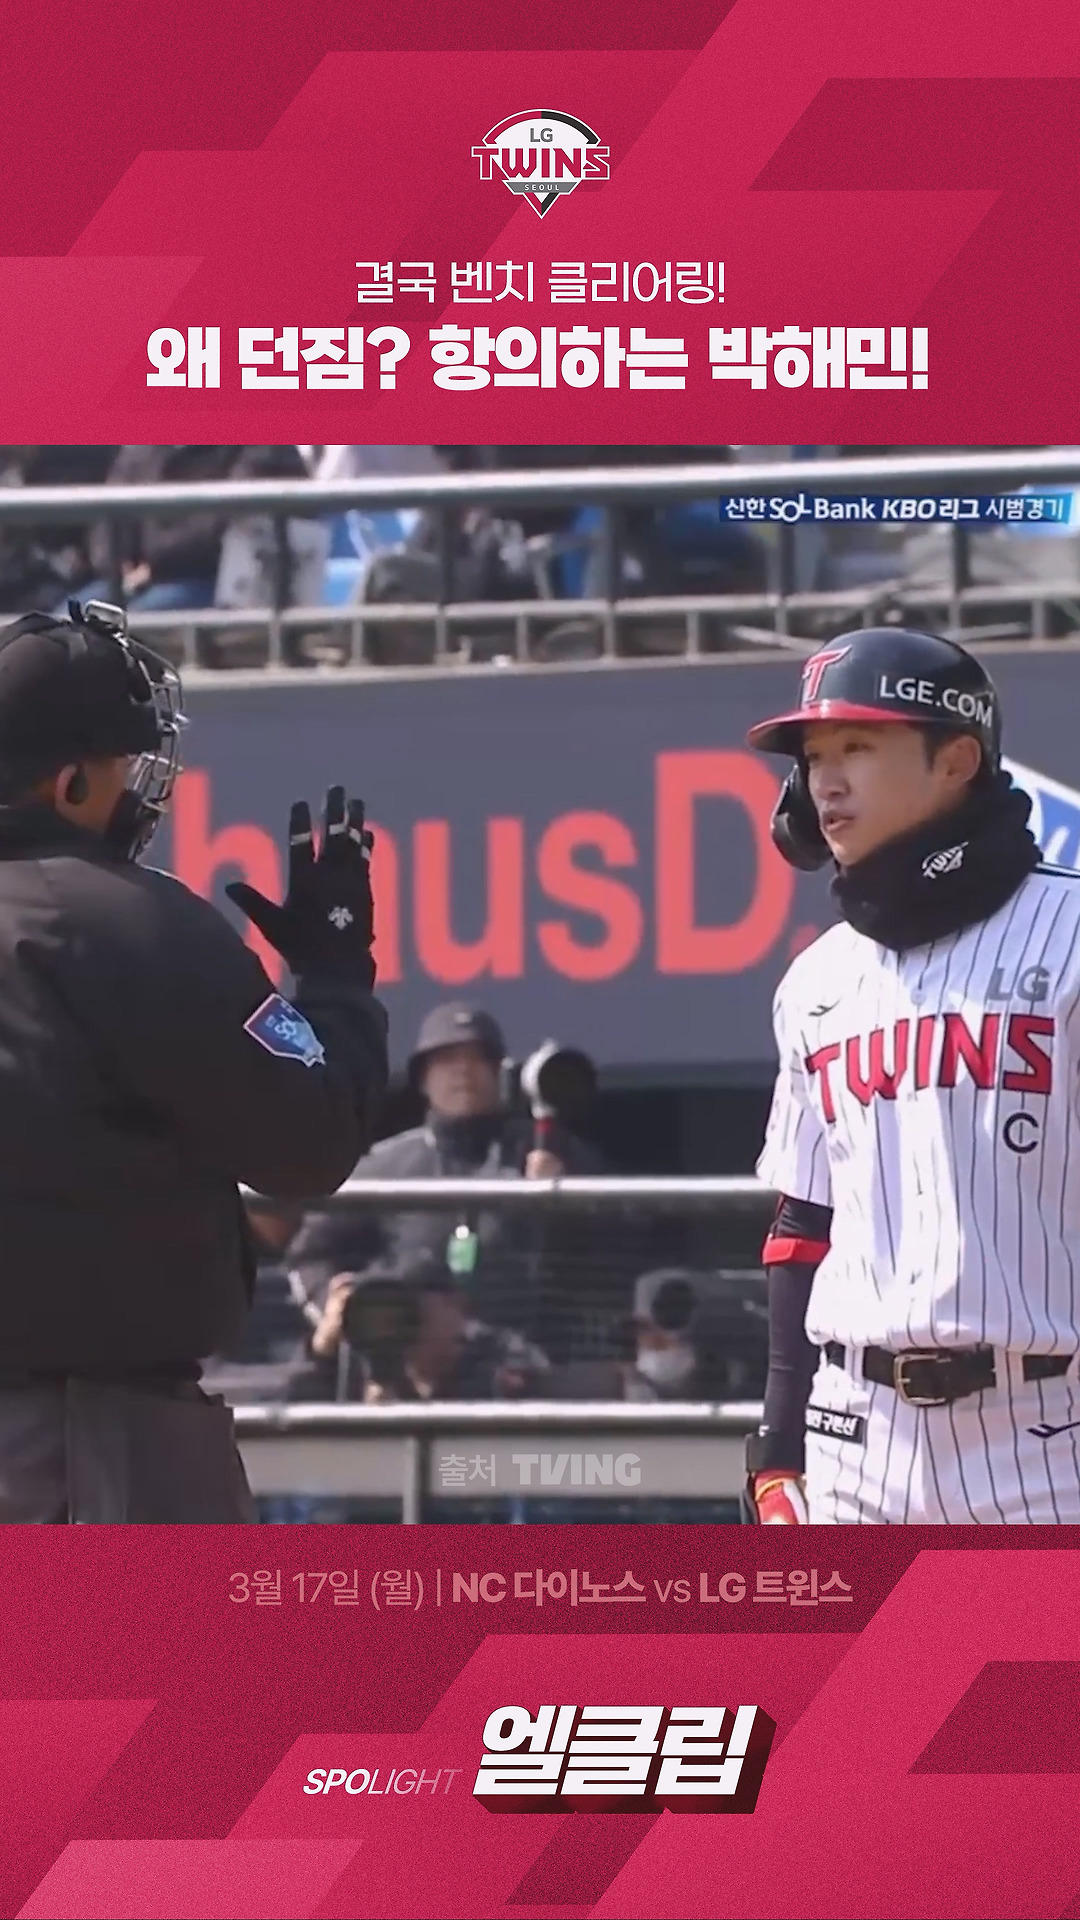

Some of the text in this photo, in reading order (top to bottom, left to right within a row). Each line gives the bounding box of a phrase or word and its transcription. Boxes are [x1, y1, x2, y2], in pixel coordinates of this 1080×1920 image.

[879, 675, 993, 728] LGE.COM
[173, 749, 818, 986] husD
[987, 965, 1051, 1002] LG
[805, 1013, 1055, 1124] TWINS
[1003, 1112, 1039, 1153] C
